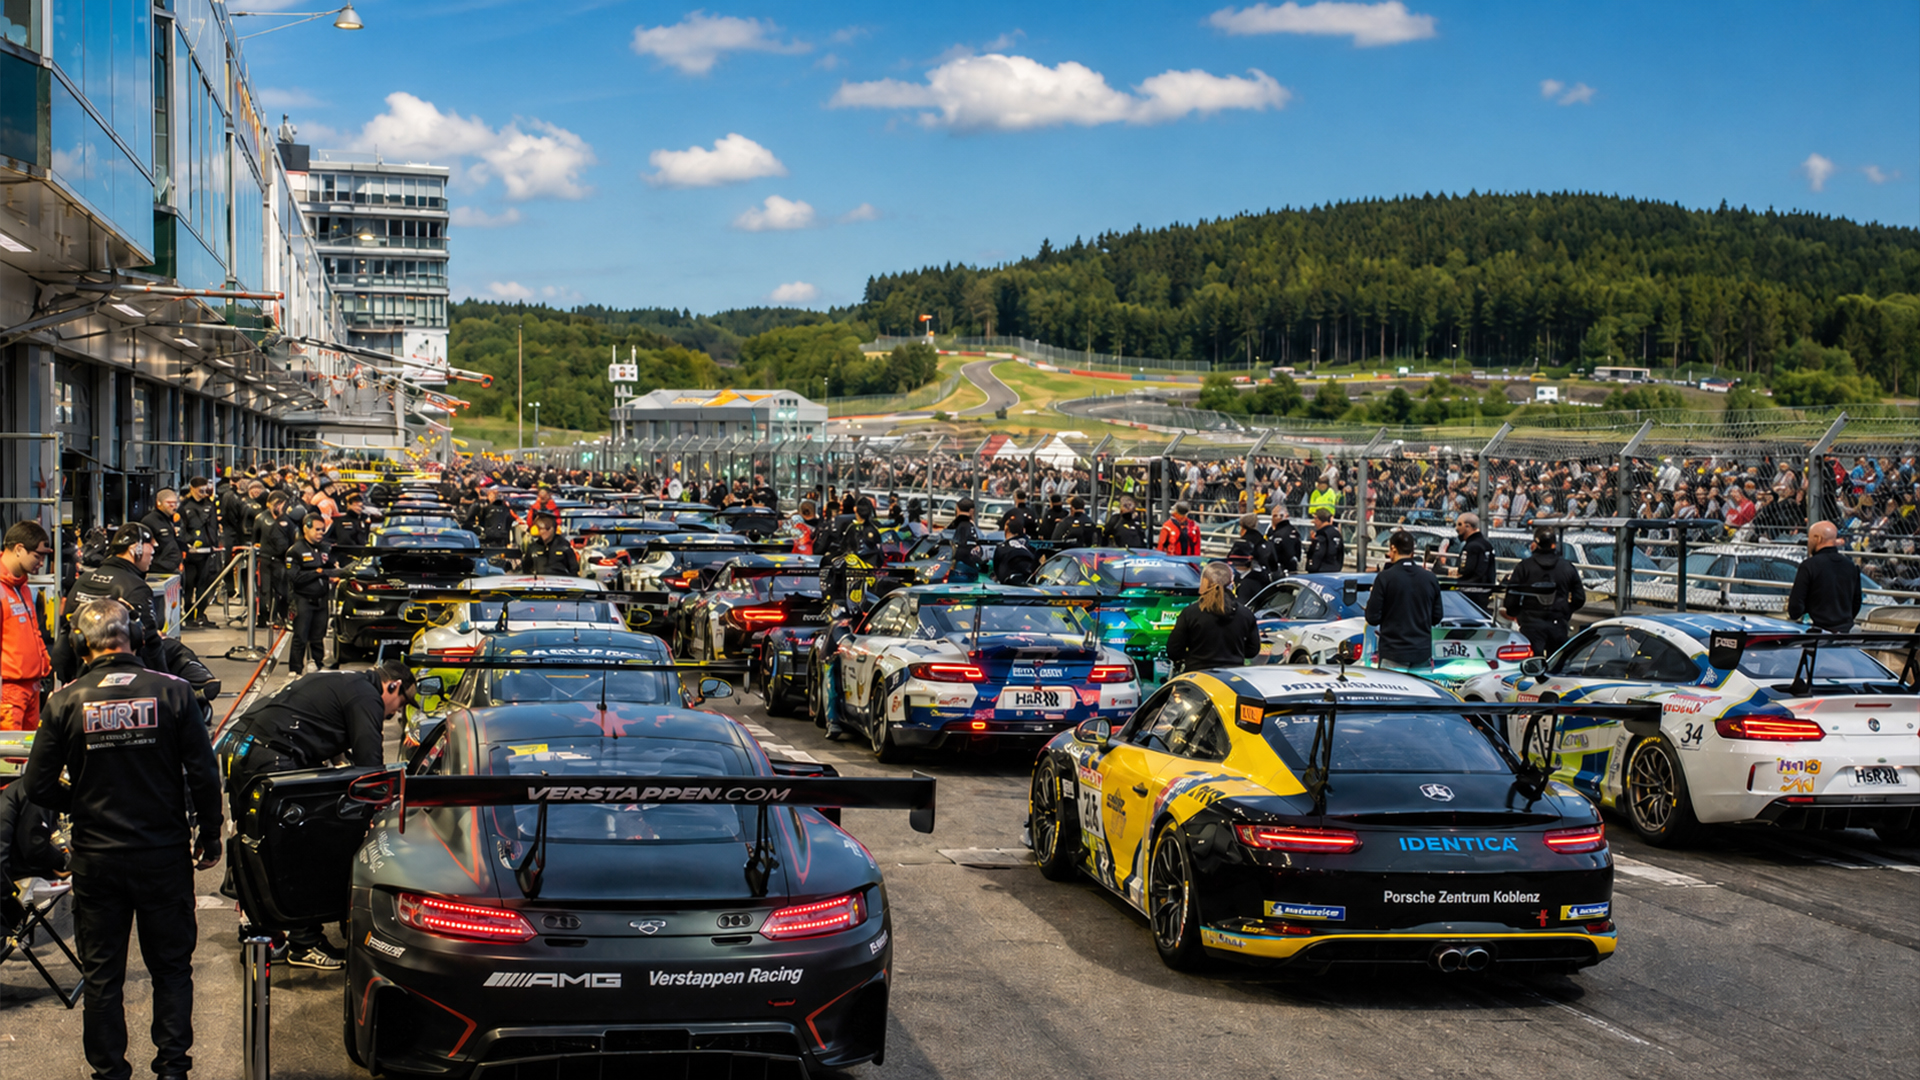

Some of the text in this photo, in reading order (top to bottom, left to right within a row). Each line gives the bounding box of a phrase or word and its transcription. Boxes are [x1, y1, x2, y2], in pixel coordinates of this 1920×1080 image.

[1681, 722, 1704, 745] 34
[527, 786, 791, 801] VERSTAPPEN.COM
[1399, 837, 1519, 852] IDENTICA
[1383, 890, 1541, 903] Porsche Zentrum Koblenz
[524, 972, 622, 988] AMG
[649, 966, 804, 988] Verstappen Racing
